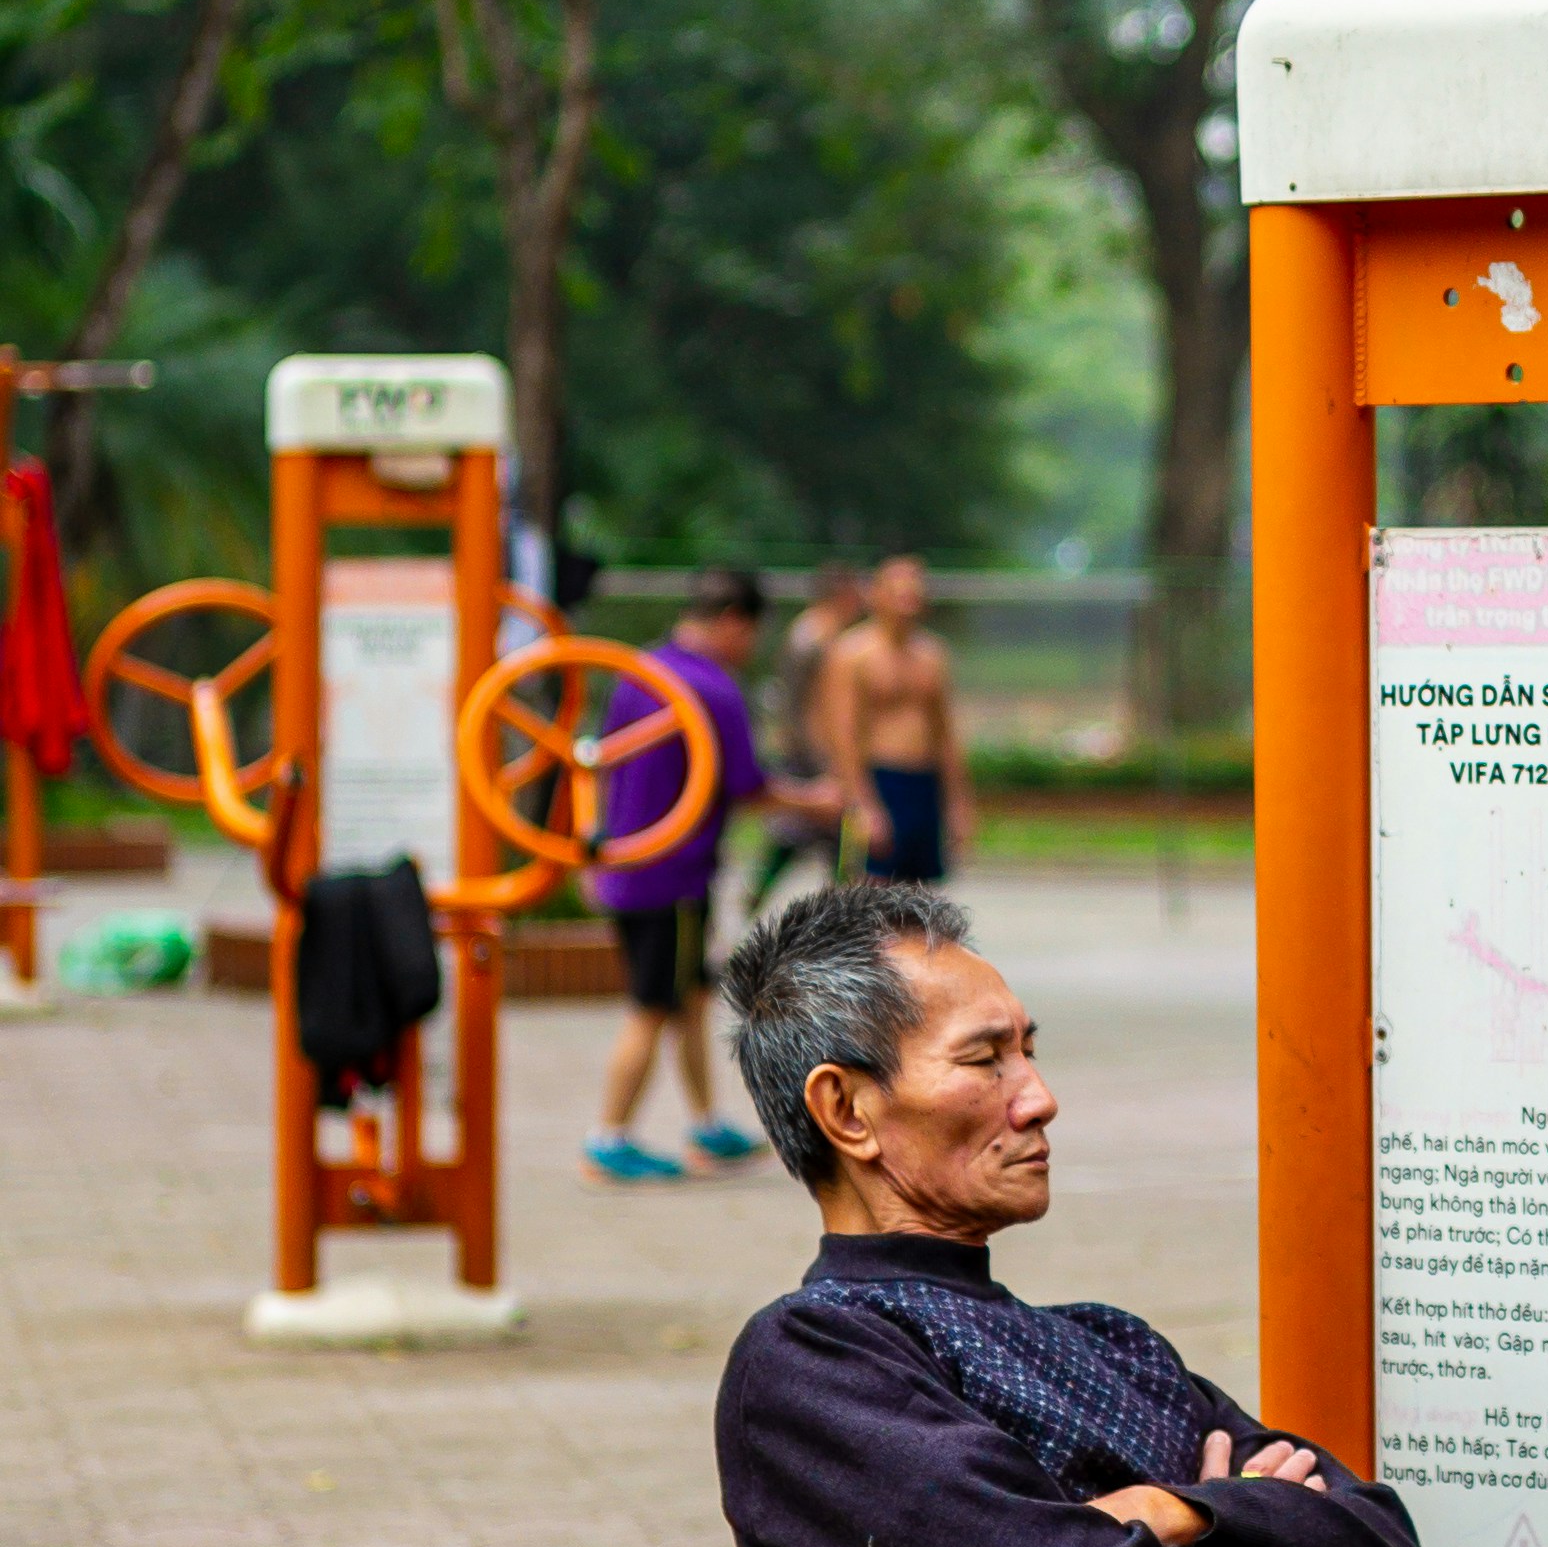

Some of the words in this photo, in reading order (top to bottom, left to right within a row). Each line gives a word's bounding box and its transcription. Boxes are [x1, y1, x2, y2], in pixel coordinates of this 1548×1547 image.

[1487, 566, 1542, 592] FWD
[1380, 678, 1474, 707] HƯỚNG
[1481, 674, 1534, 707] DẪN
[1416, 717, 1464, 751] TẬP
[1471, 722, 1541, 746] LƯNG
[1449, 761, 1506, 785] VIFA
[1379, 1132, 1417, 1154] ghế,
[1424, 1133, 1448, 1151] hai
[1454, 1135, 1496, 1153] chân
[1502, 1139, 1539, 1155] móc
[1380, 1166, 1439, 1186] ngang;
[1444, 1164, 1479, 1187] Ngả
[1484, 1168, 1532, 1189] người
[1380, 1191, 1424, 1215] bụng
[1430, 1193, 1483, 1218] không
[1489, 1196, 1516, 1215] thả
[1379, 1220, 1400, 1239] về
[1406, 1223, 1442, 1244] phía
[1448, 1226, 1500, 1246] trước;
[1506, 1226, 1532, 1245] Có
[1380, 1251, 1392, 1269] ở
[1395, 1257, 1424, 1270] sau
[1428, 1255, 1458, 1276] gáy
[1462, 1253, 1484, 1273] để
[1487, 1257, 1515, 1279] tập
[1380, 1297, 1411, 1316] Kết
[1415, 1298, 1448, 1321] hợp
[1452, 1300, 1474, 1319] hít
[1477, 1302, 1507, 1321] thở
[1511, 1303, 1548, 1322] đều:
[1380, 1332, 1416, 1348] sau,
[1424, 1328, 1446, 1347] hít
[1453, 1332, 1489, 1353] vào;
[1498, 1332, 1534, 1356] Gập
[1437, 1360, 1467, 1378] thở
[1470, 1366, 1491, 1380] ra.
[1485, 1407, 1510, 1427] Hỗ
[1516, 1412, 1542, 1432] trợ
[1382, 1434, 1402, 1450] và
[1408, 1433, 1428, 1452] hệ
[1434, 1434, 1456, 1454] hô
[1462, 1436, 1500, 1460] hấp;
[1506, 1439, 1538, 1459] Tác
[1383, 1462, 1432, 1486] bụng,
[1436, 1465, 1474, 1489] lưng
[1477, 1470, 1497, 1486] và
[1501, 1474, 1522, 1488] cơ
